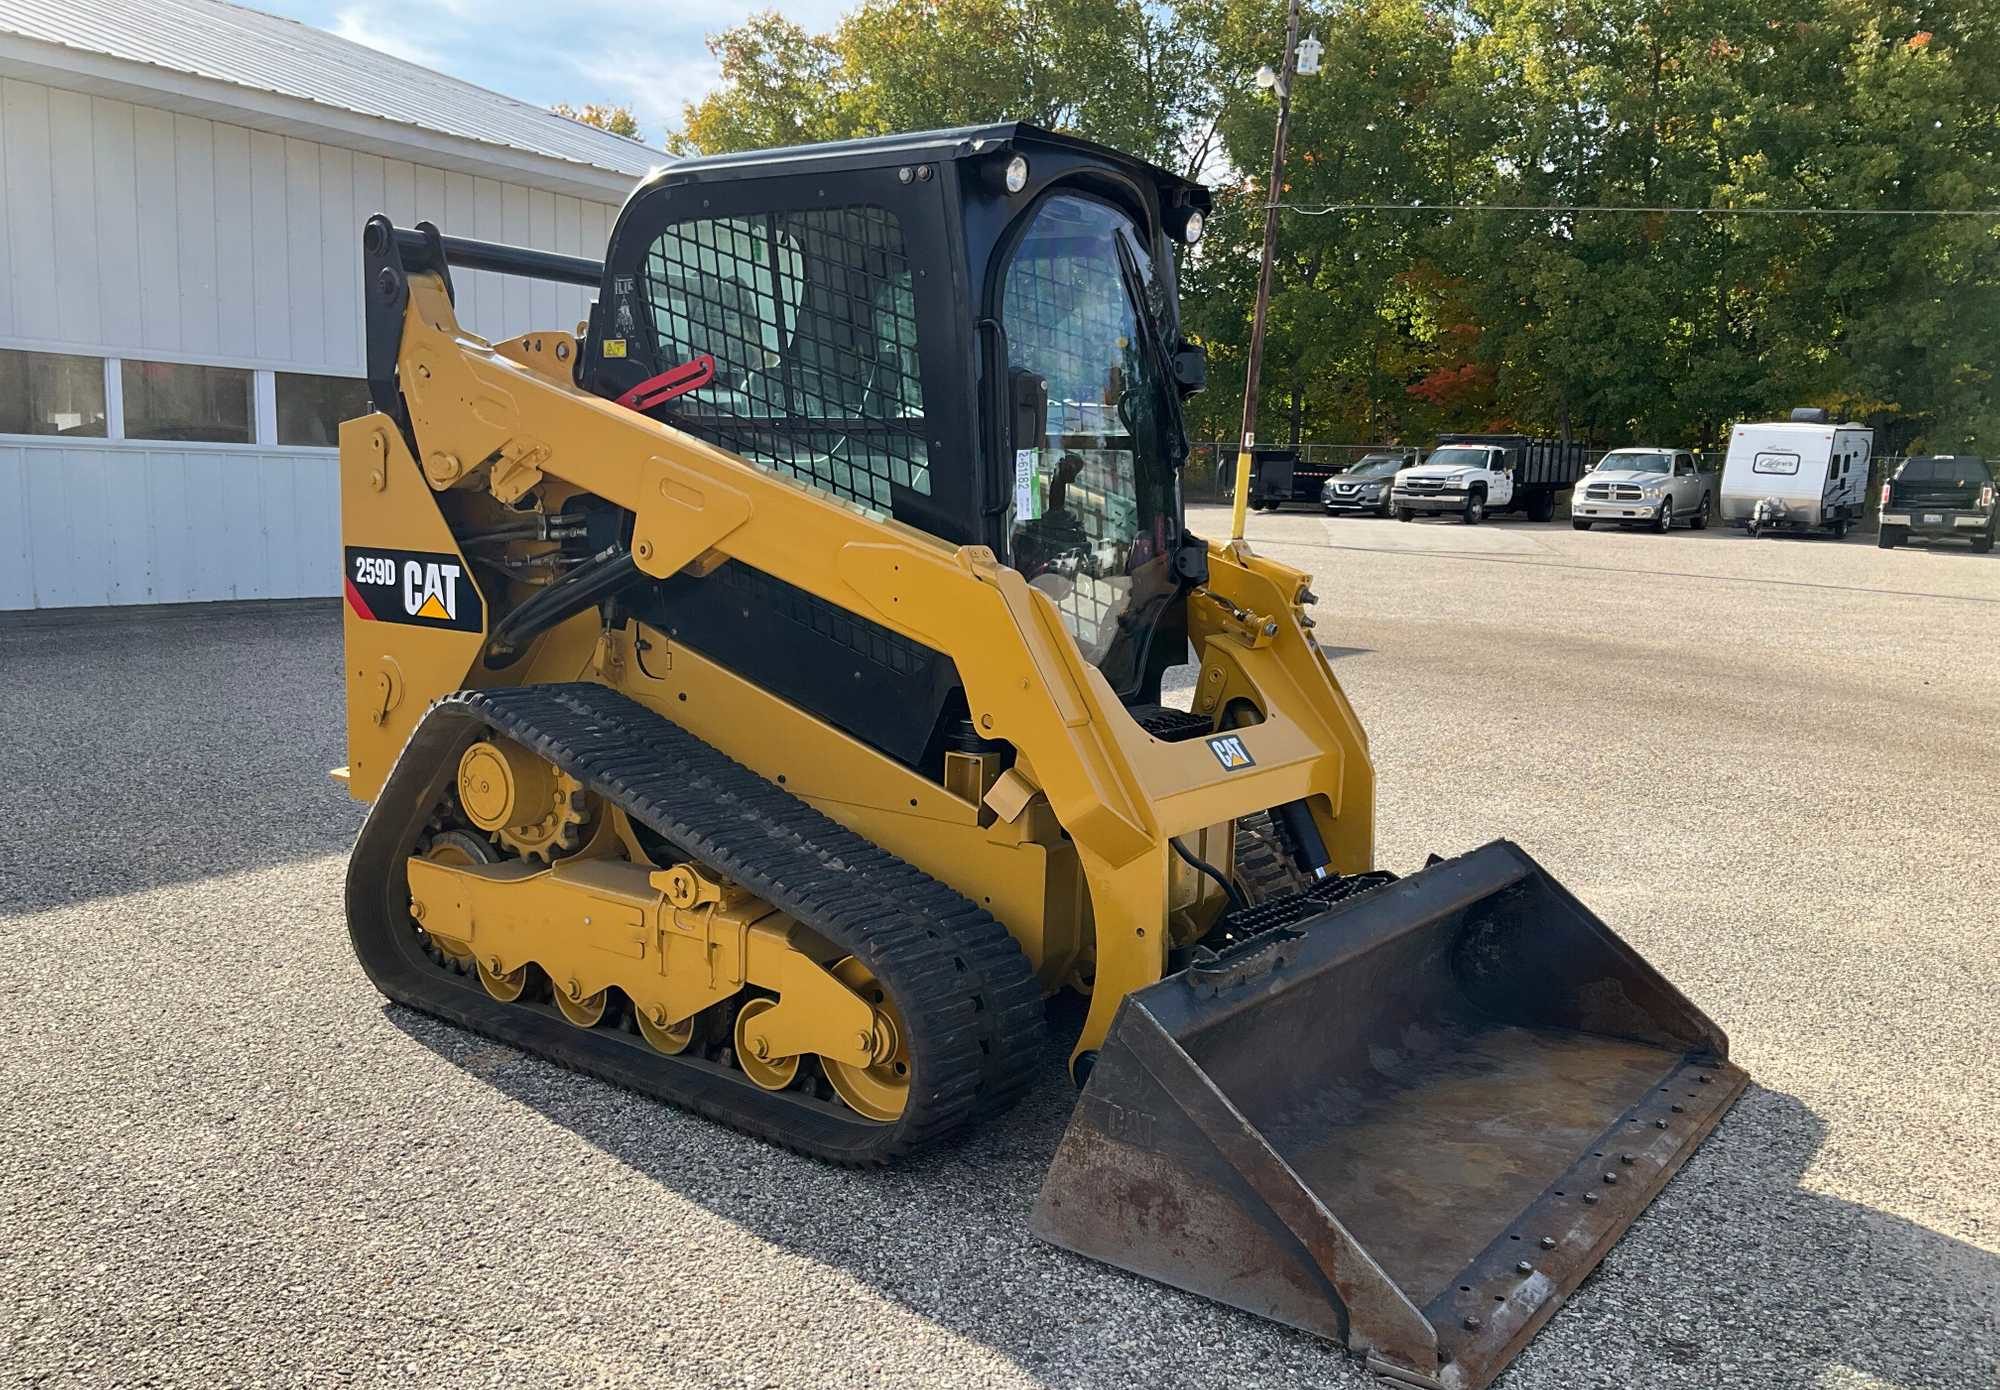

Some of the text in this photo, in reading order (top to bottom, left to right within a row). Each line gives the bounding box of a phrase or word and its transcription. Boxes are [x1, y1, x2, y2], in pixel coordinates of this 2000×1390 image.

[356, 556, 460, 620] 259D CAT
[1211, 737, 1250, 767] CAT
